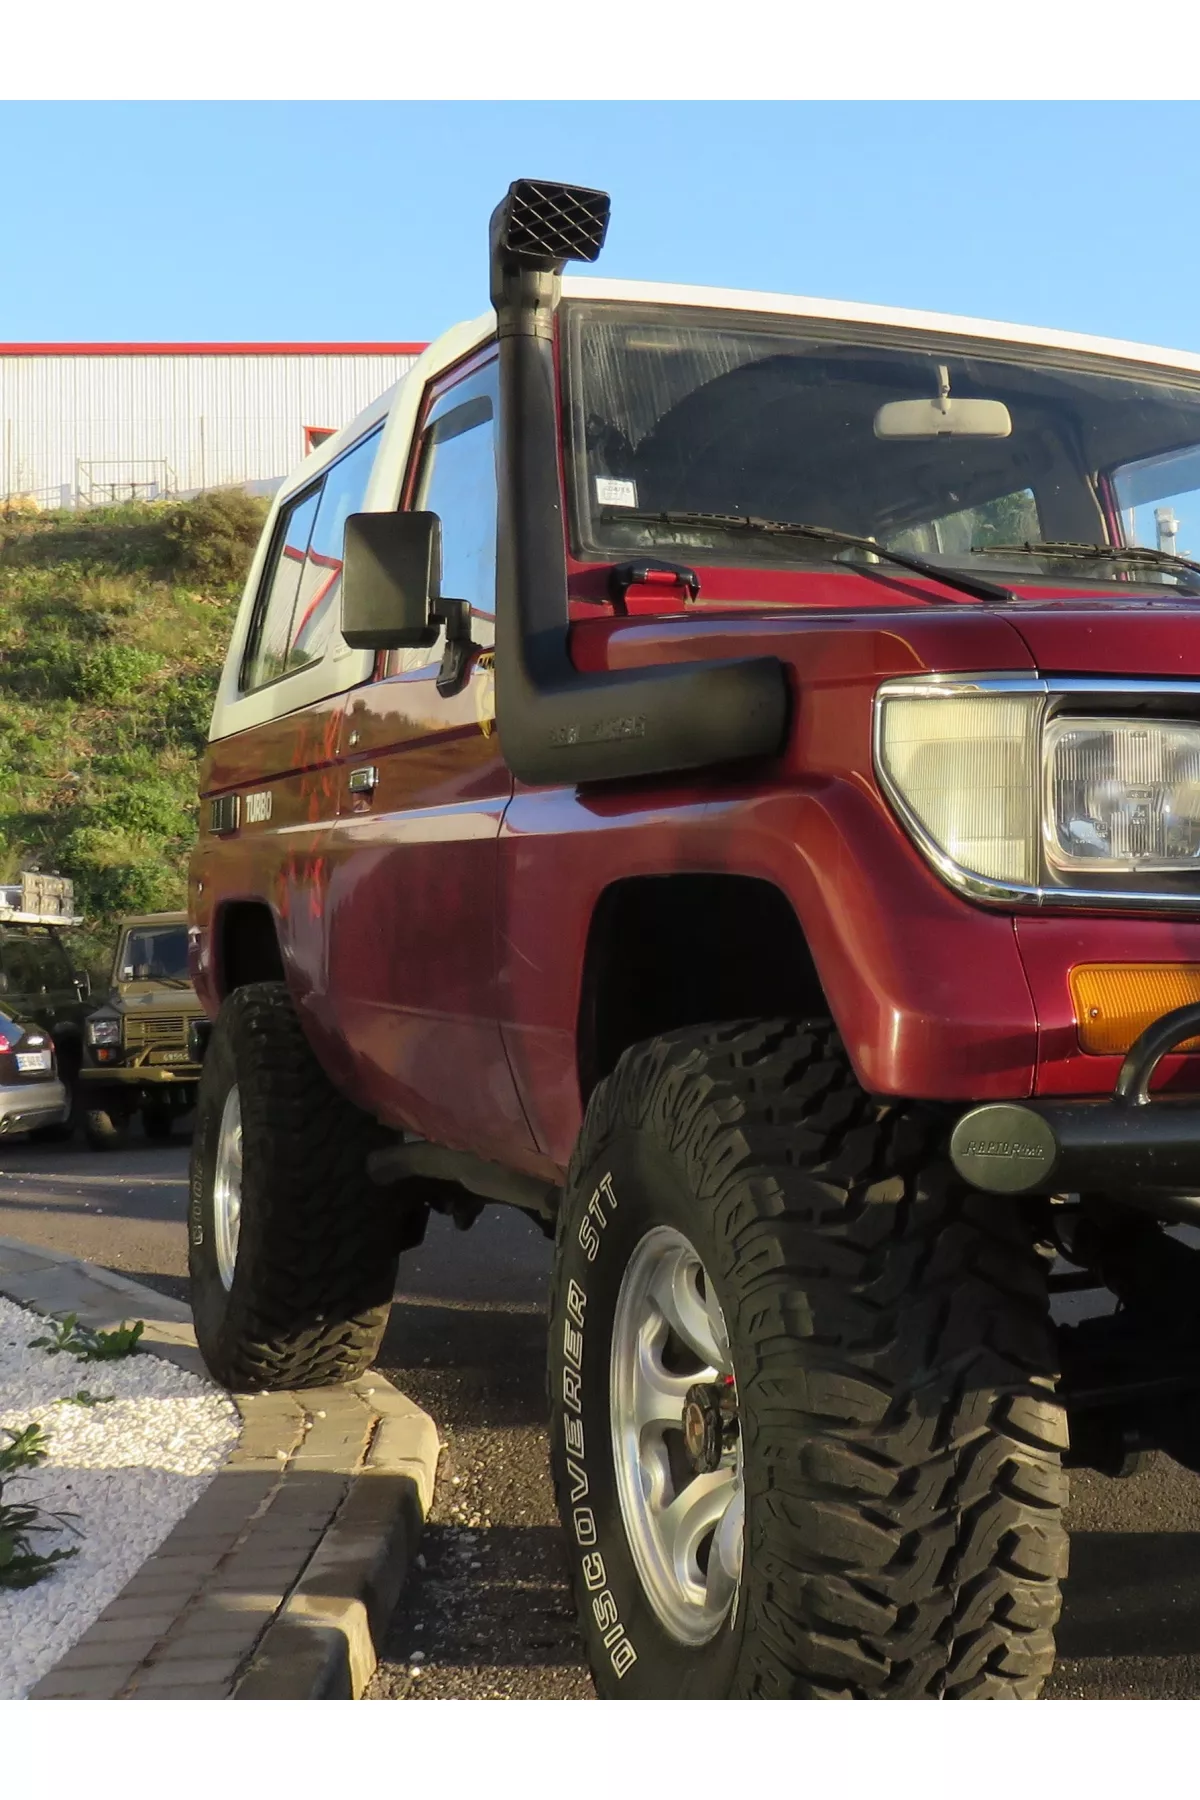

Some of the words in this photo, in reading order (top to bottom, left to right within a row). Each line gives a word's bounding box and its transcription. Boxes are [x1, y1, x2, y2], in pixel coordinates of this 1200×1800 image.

[246, 791, 272, 823] TURBO
[579, 1172, 617, 1261] STT
[563, 1278, 638, 1679] DISCOVERER
